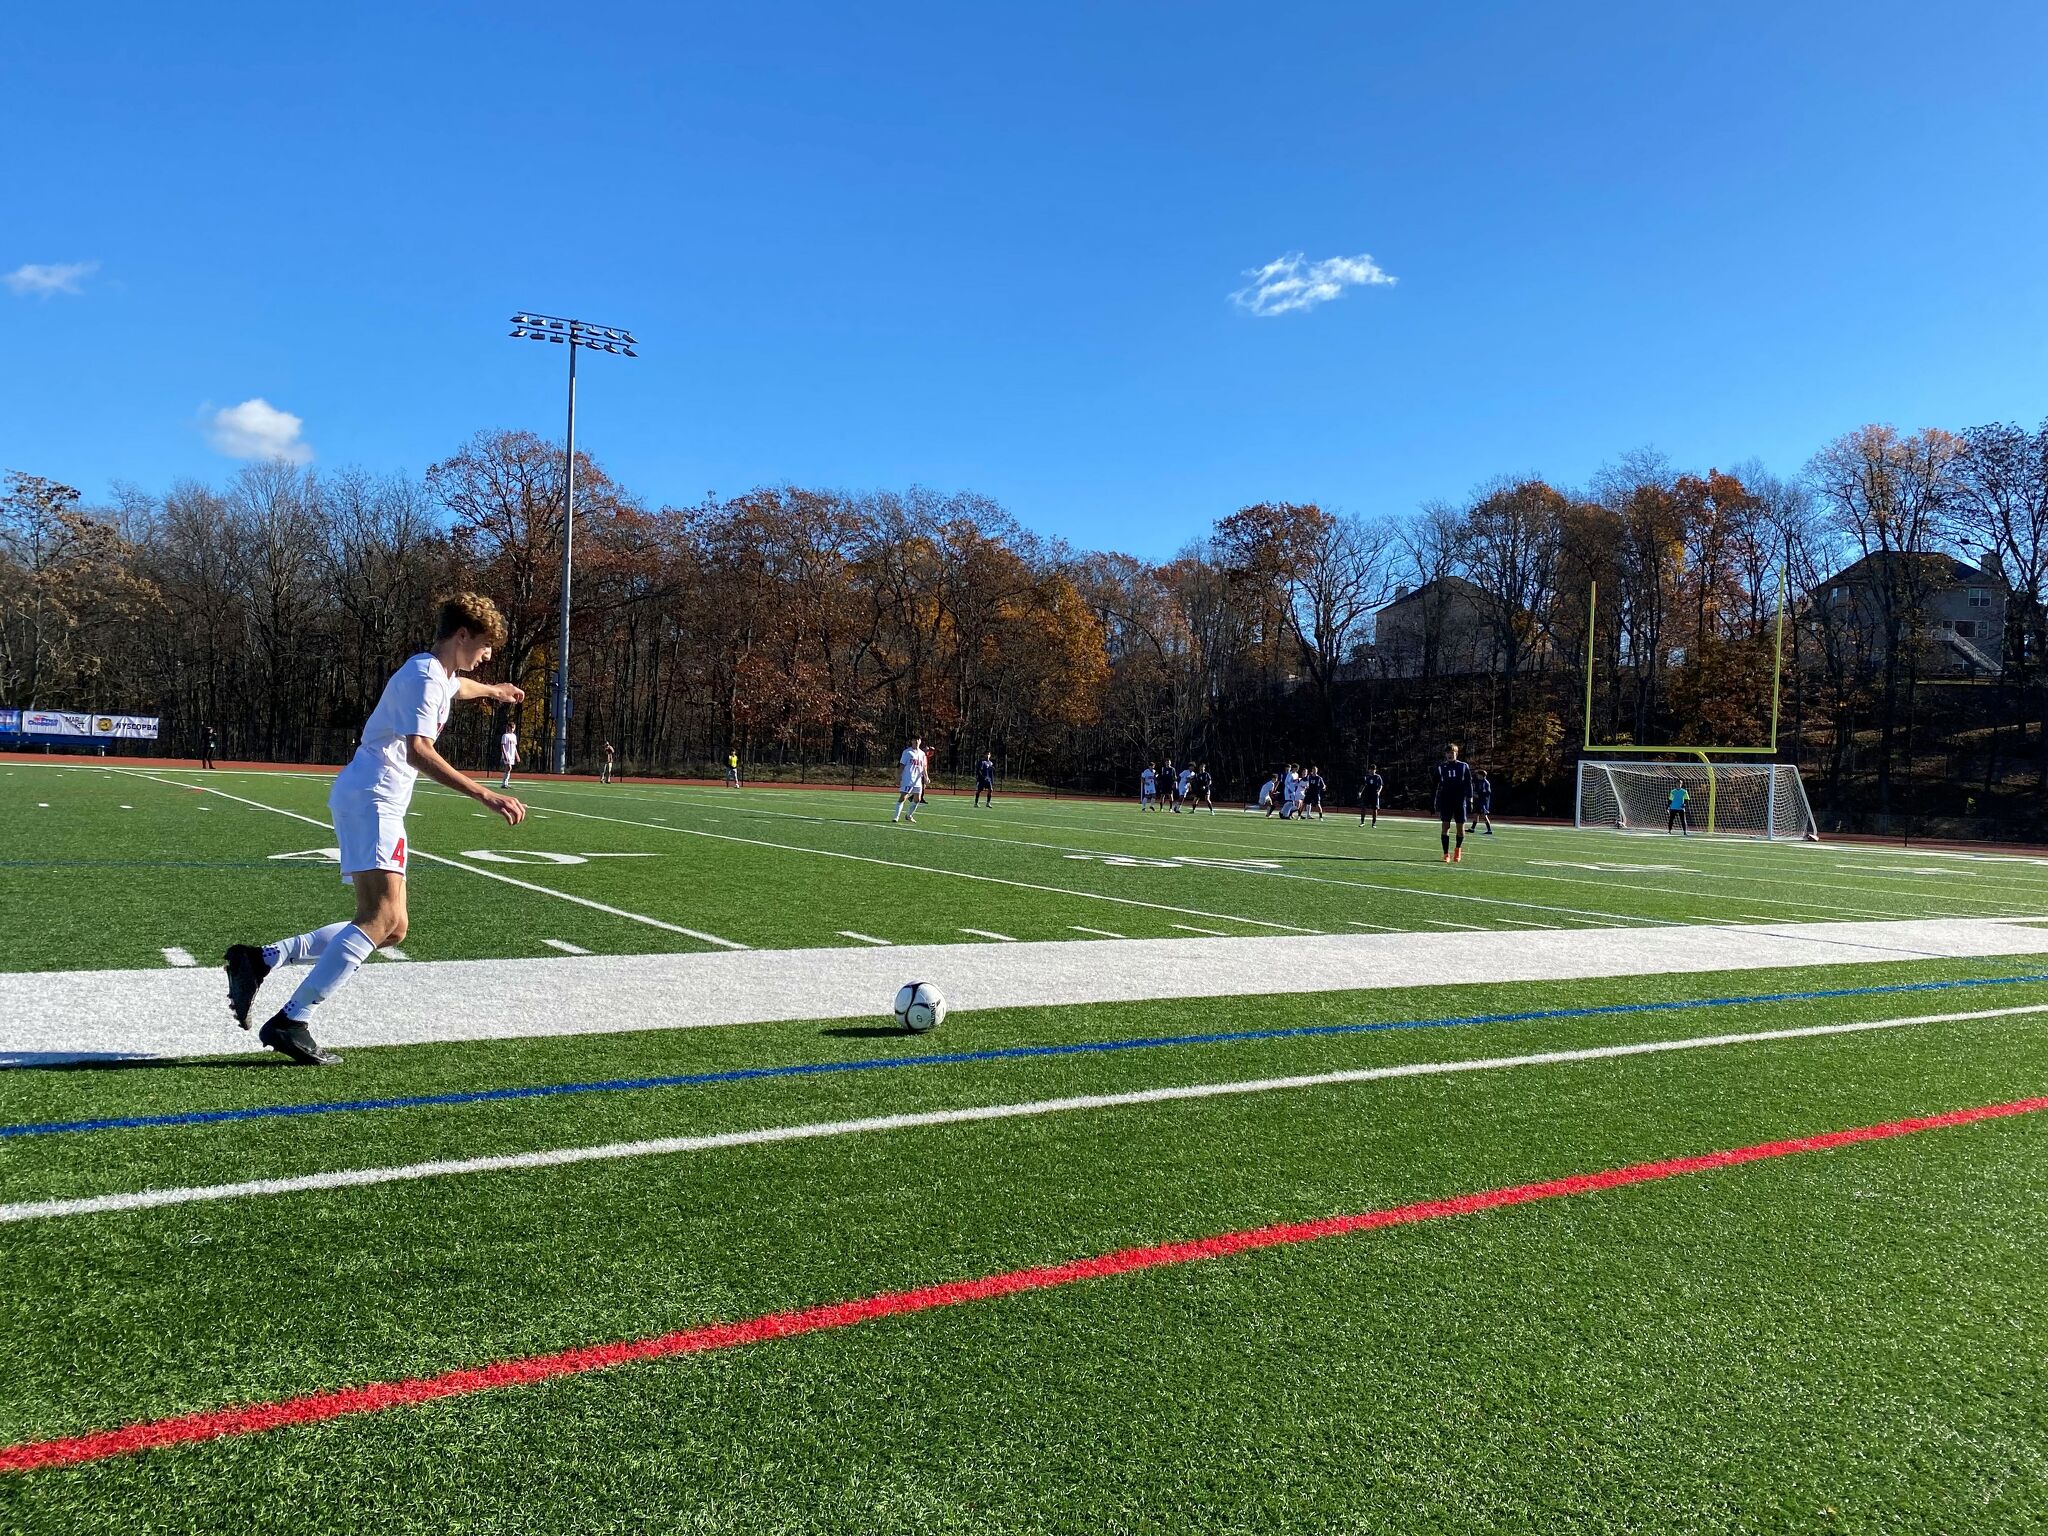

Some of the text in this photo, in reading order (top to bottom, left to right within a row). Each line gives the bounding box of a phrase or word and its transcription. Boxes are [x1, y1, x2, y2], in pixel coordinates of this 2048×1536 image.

[116, 722, 157, 731] NYSCOPBA
[1447, 769, 1457, 778] 11
[390, 837, 405, 868] 4
